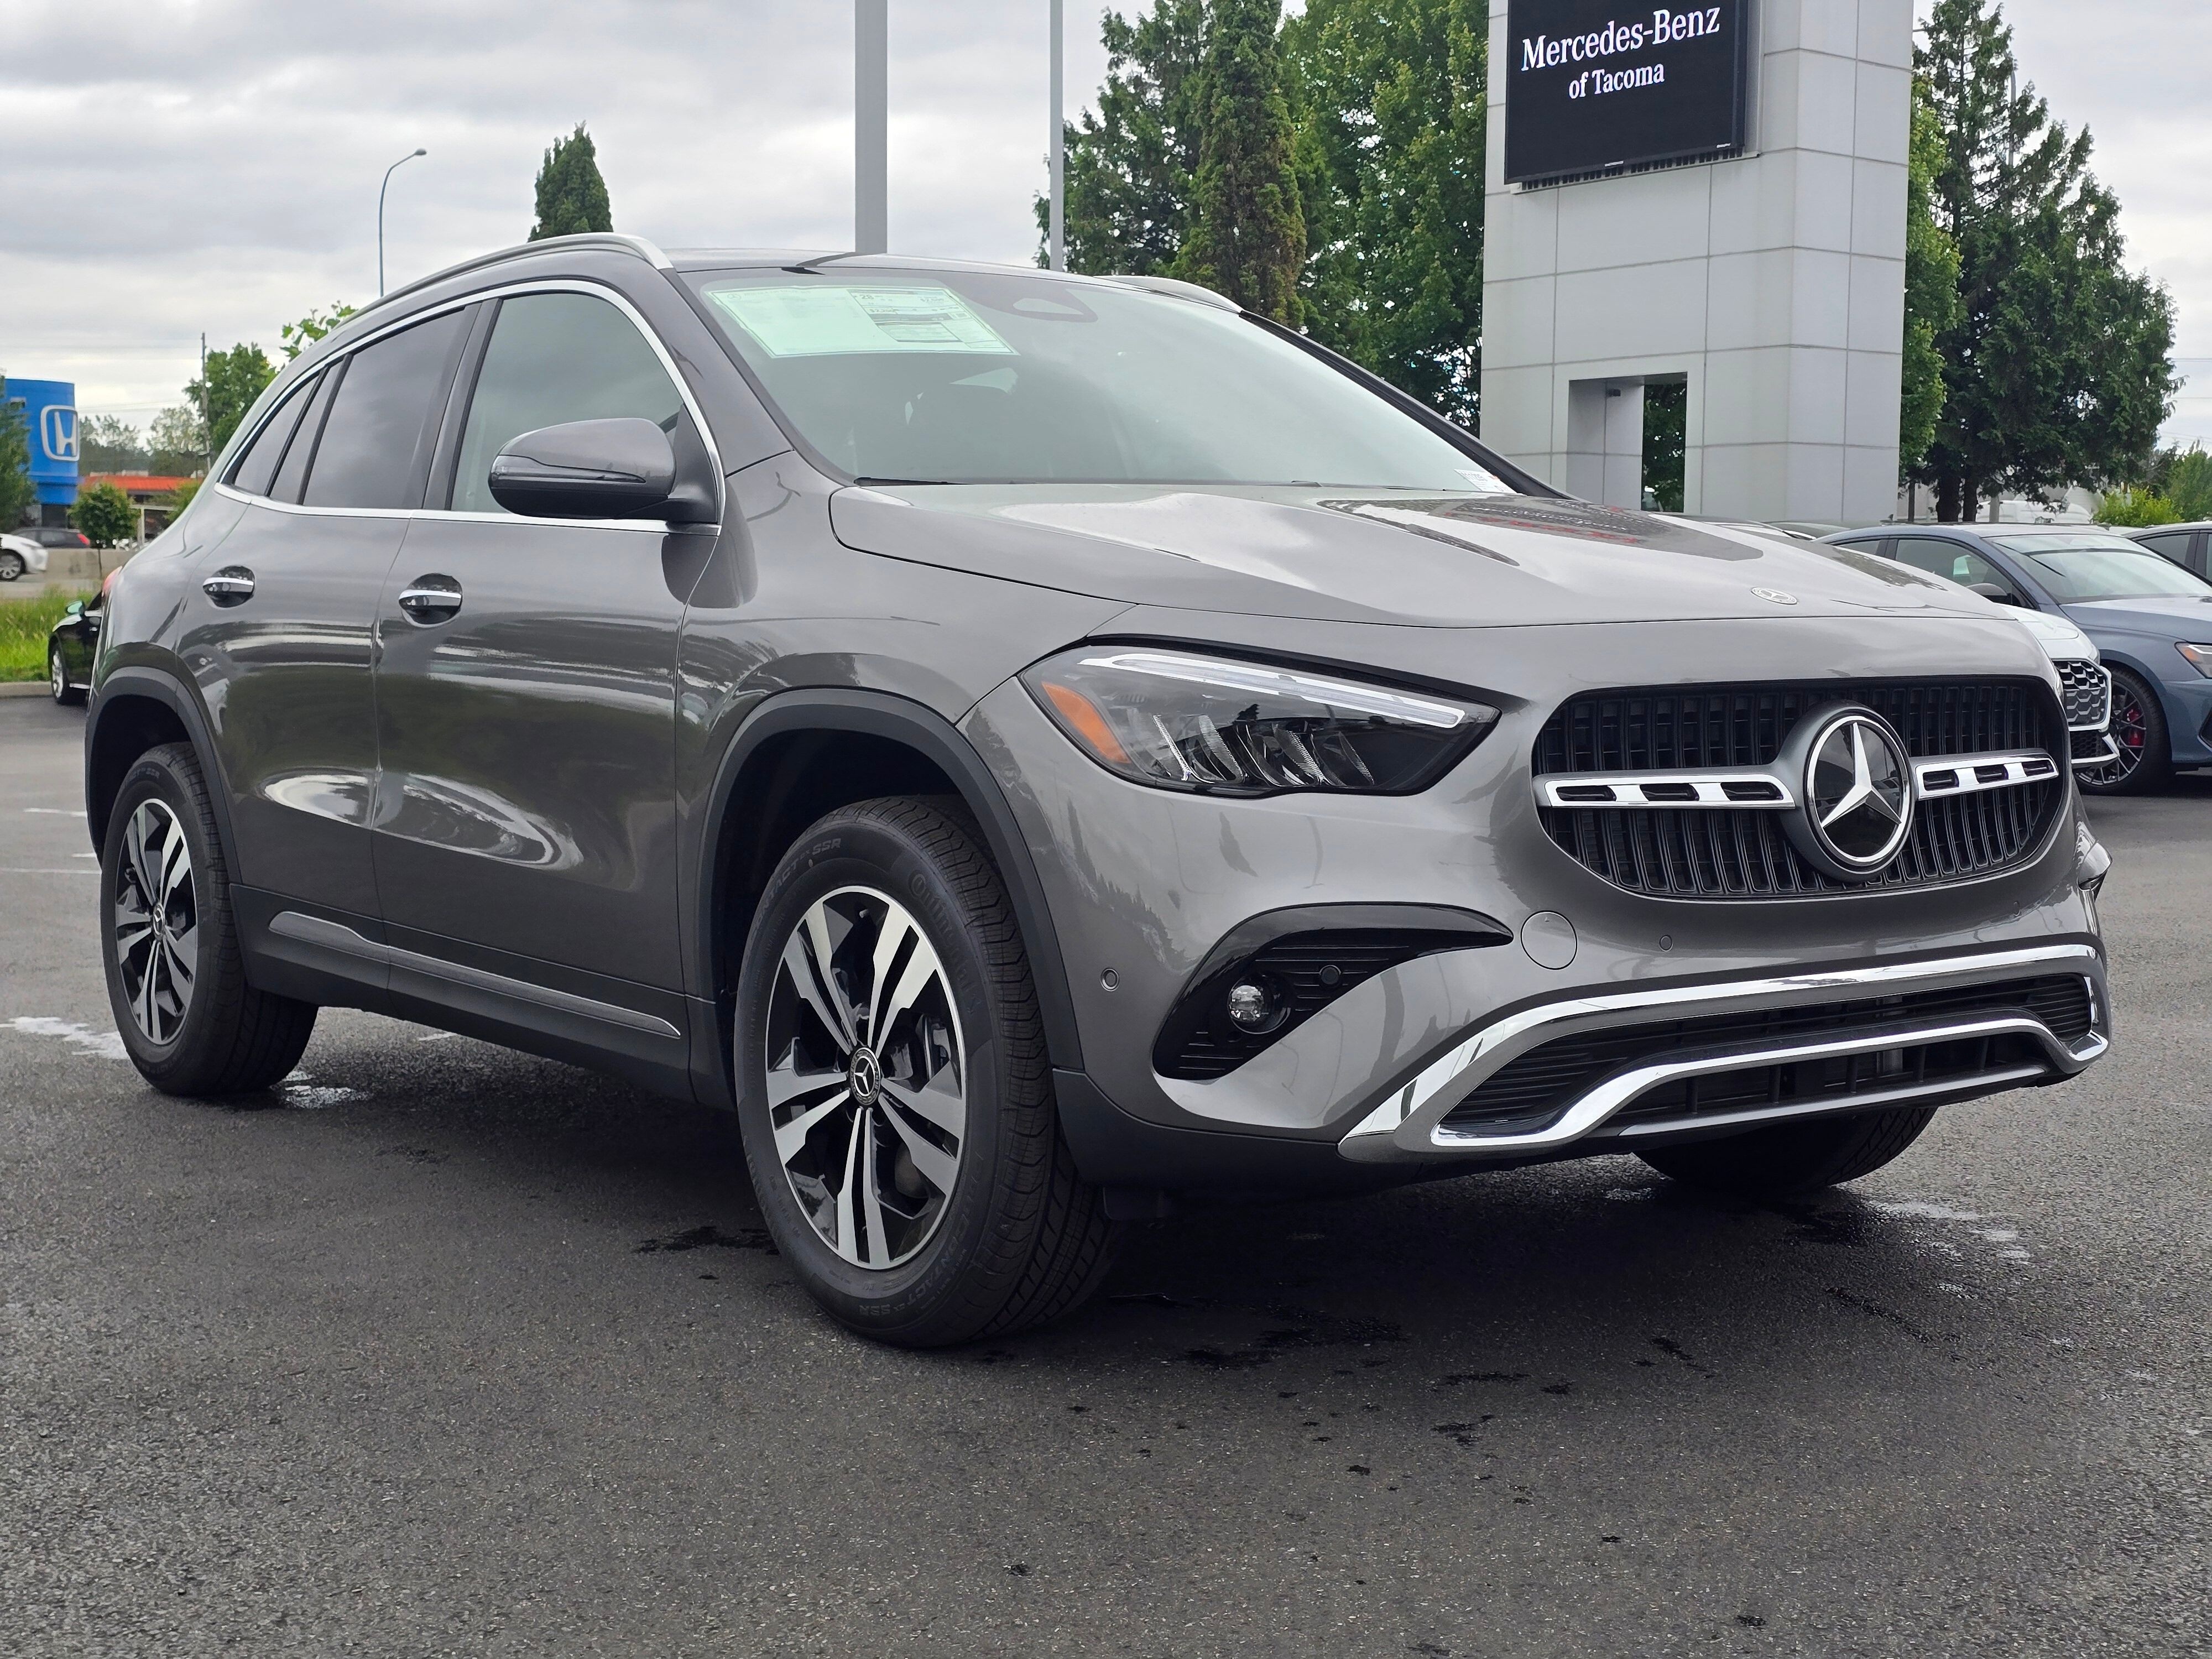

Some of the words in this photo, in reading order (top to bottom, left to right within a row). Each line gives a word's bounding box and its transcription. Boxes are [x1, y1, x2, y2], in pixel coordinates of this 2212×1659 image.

[1522, 7, 1720, 71] Mercedes-Benz
[1569, 72, 1588, 99] of
[1592, 64, 1665, 95] Tacoma
[812, 838, 841, 855] SSR
